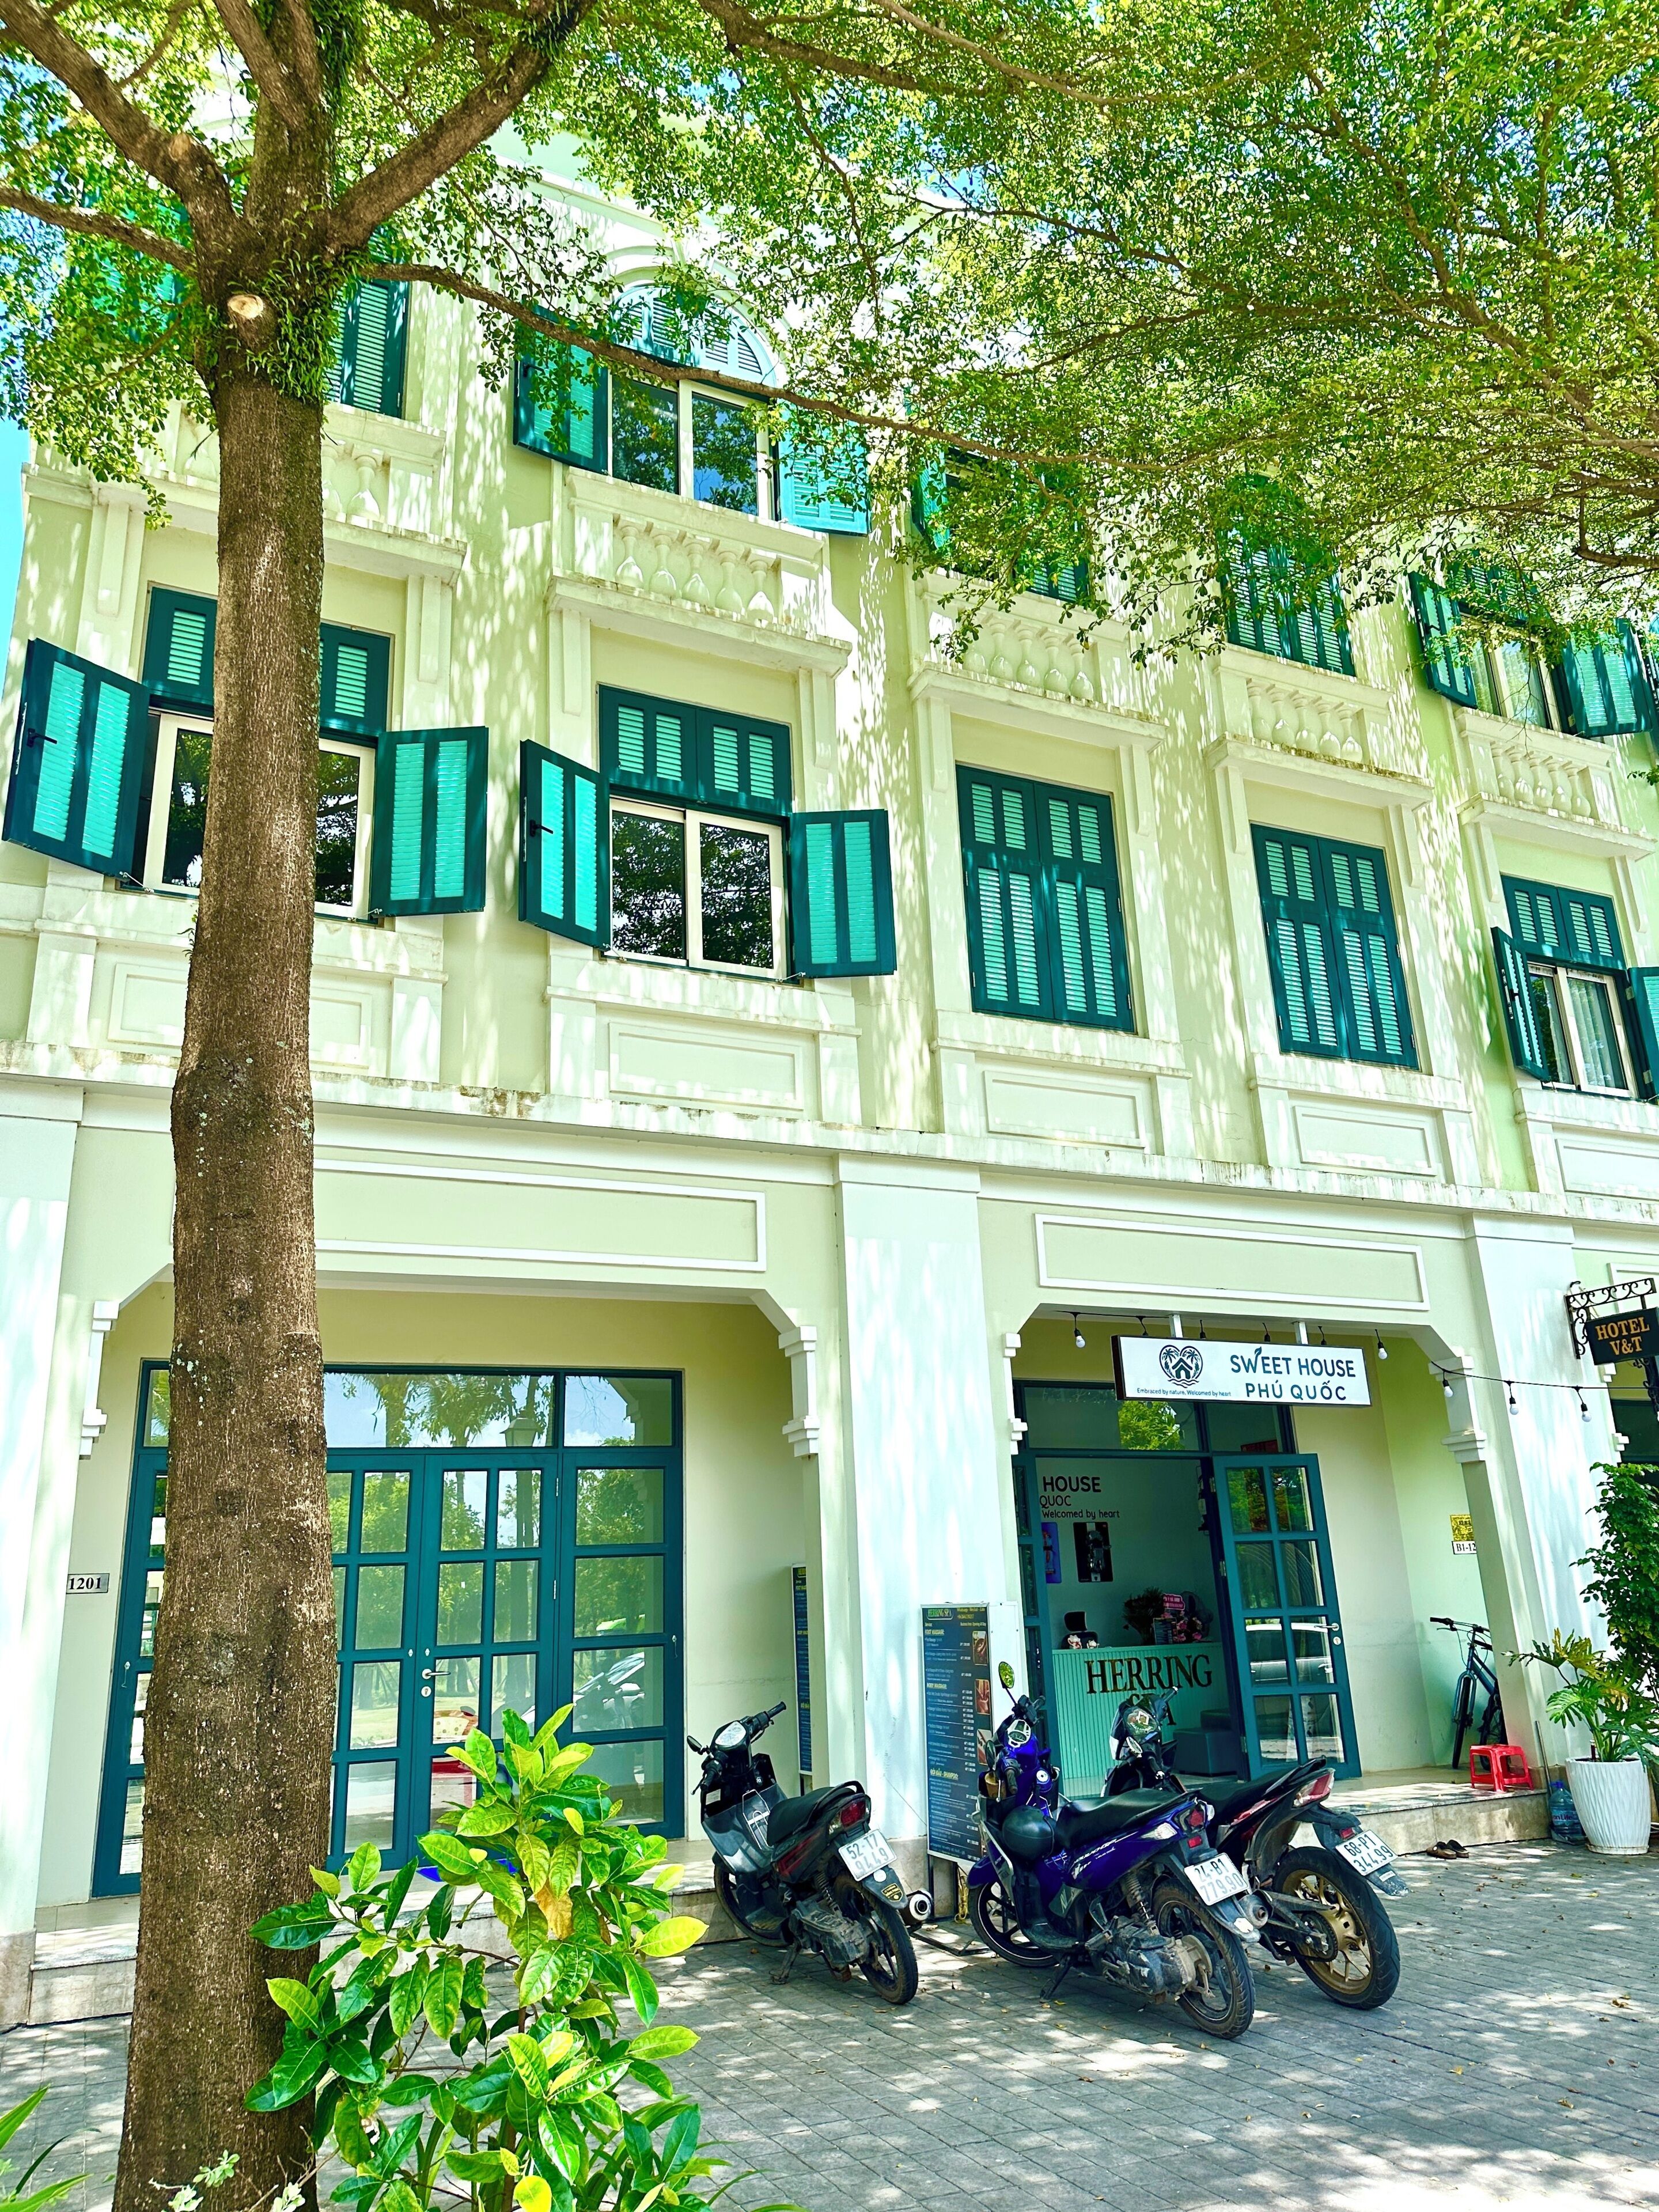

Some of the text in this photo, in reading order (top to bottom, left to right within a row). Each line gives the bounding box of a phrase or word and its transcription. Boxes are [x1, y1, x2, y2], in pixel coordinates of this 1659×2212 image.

[1594, 1317, 1650, 1340] HOTEL
[1609, 1336, 1642, 1355] V&T
[1230, 1347, 1355, 1377] SWEET HOUSE
[1246, 1379, 1346, 1400] PHÚ QUỐC
[1043, 1476, 1101, 1493] HOUSE
[1040, 1495, 1072, 1509] QUOC
[1042, 1509, 1120, 1520] Welcomed by heart
[69, 1577, 101, 1590] 1201
[1084, 1654, 1212, 1694] HERRING
[846, 1833, 878, 1859] 52-T7
[1344, 1834, 1376, 1856] 68-P1
[855, 1847, 889, 1872] 9449
[1195, 1858, 1229, 1883] 24-B1
[1354, 1846, 1393, 1872] 344.99
[1200, 1873, 1244, 1902] 779.90
